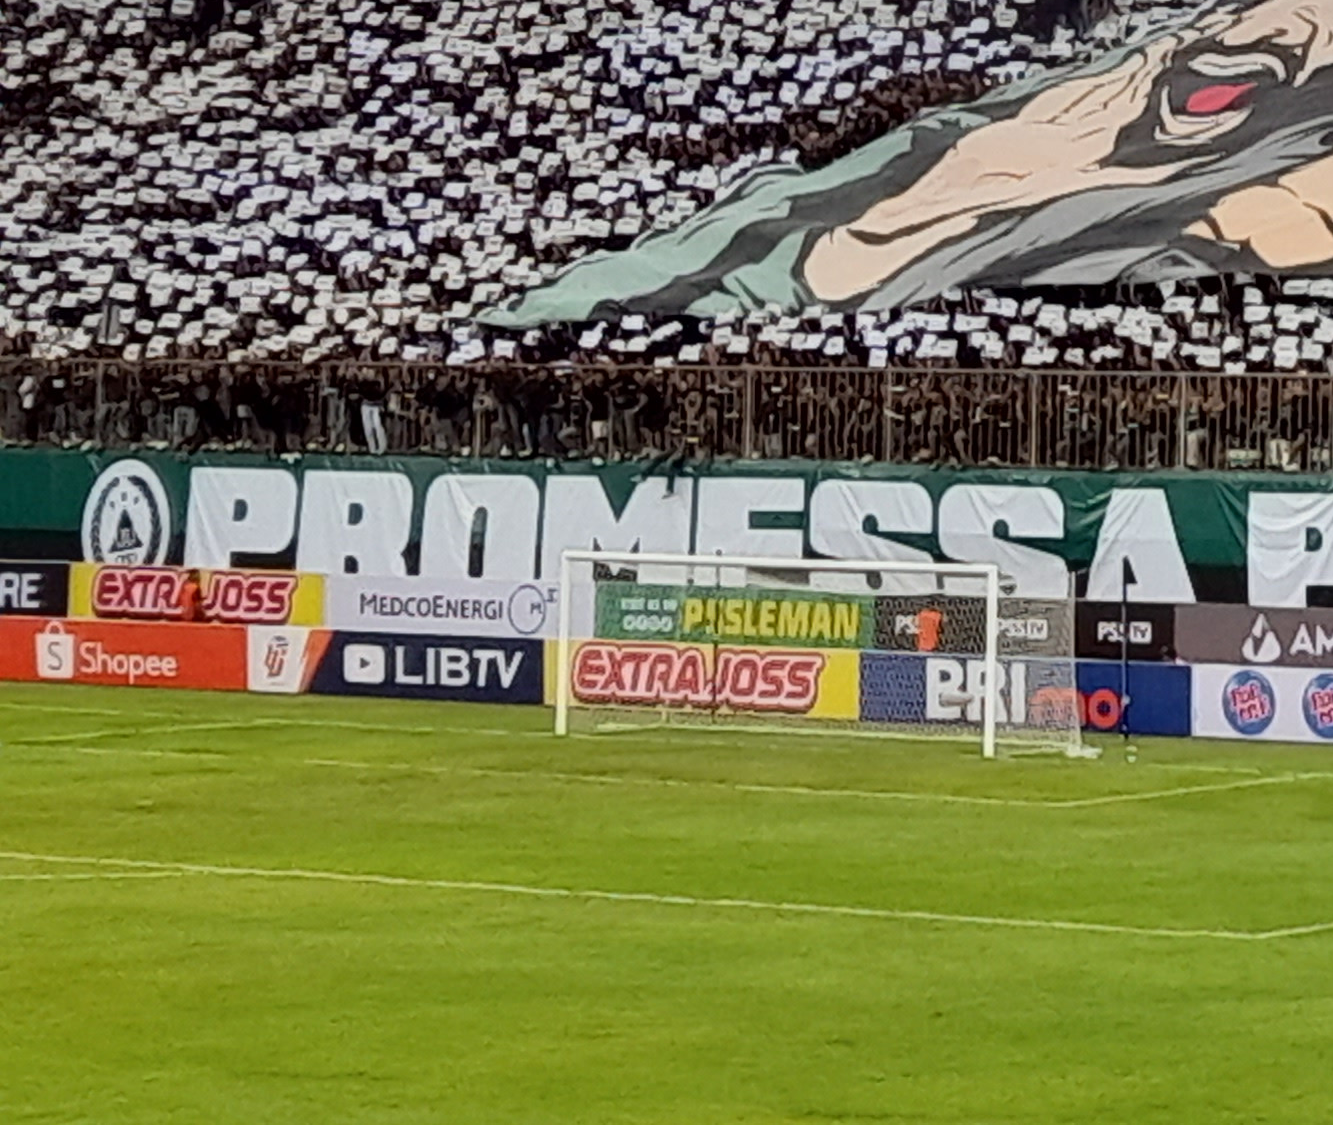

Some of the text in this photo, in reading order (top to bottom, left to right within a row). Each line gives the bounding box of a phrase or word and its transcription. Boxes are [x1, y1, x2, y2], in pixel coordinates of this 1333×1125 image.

[184, 467, 1197, 603] PROMESSA
[205, 578, 292, 617] JOSS
[78, 641, 179, 685] Shopee
[394, 644, 525, 690] LIBTV
[575, 648, 820, 704] EXTRA JOSS
